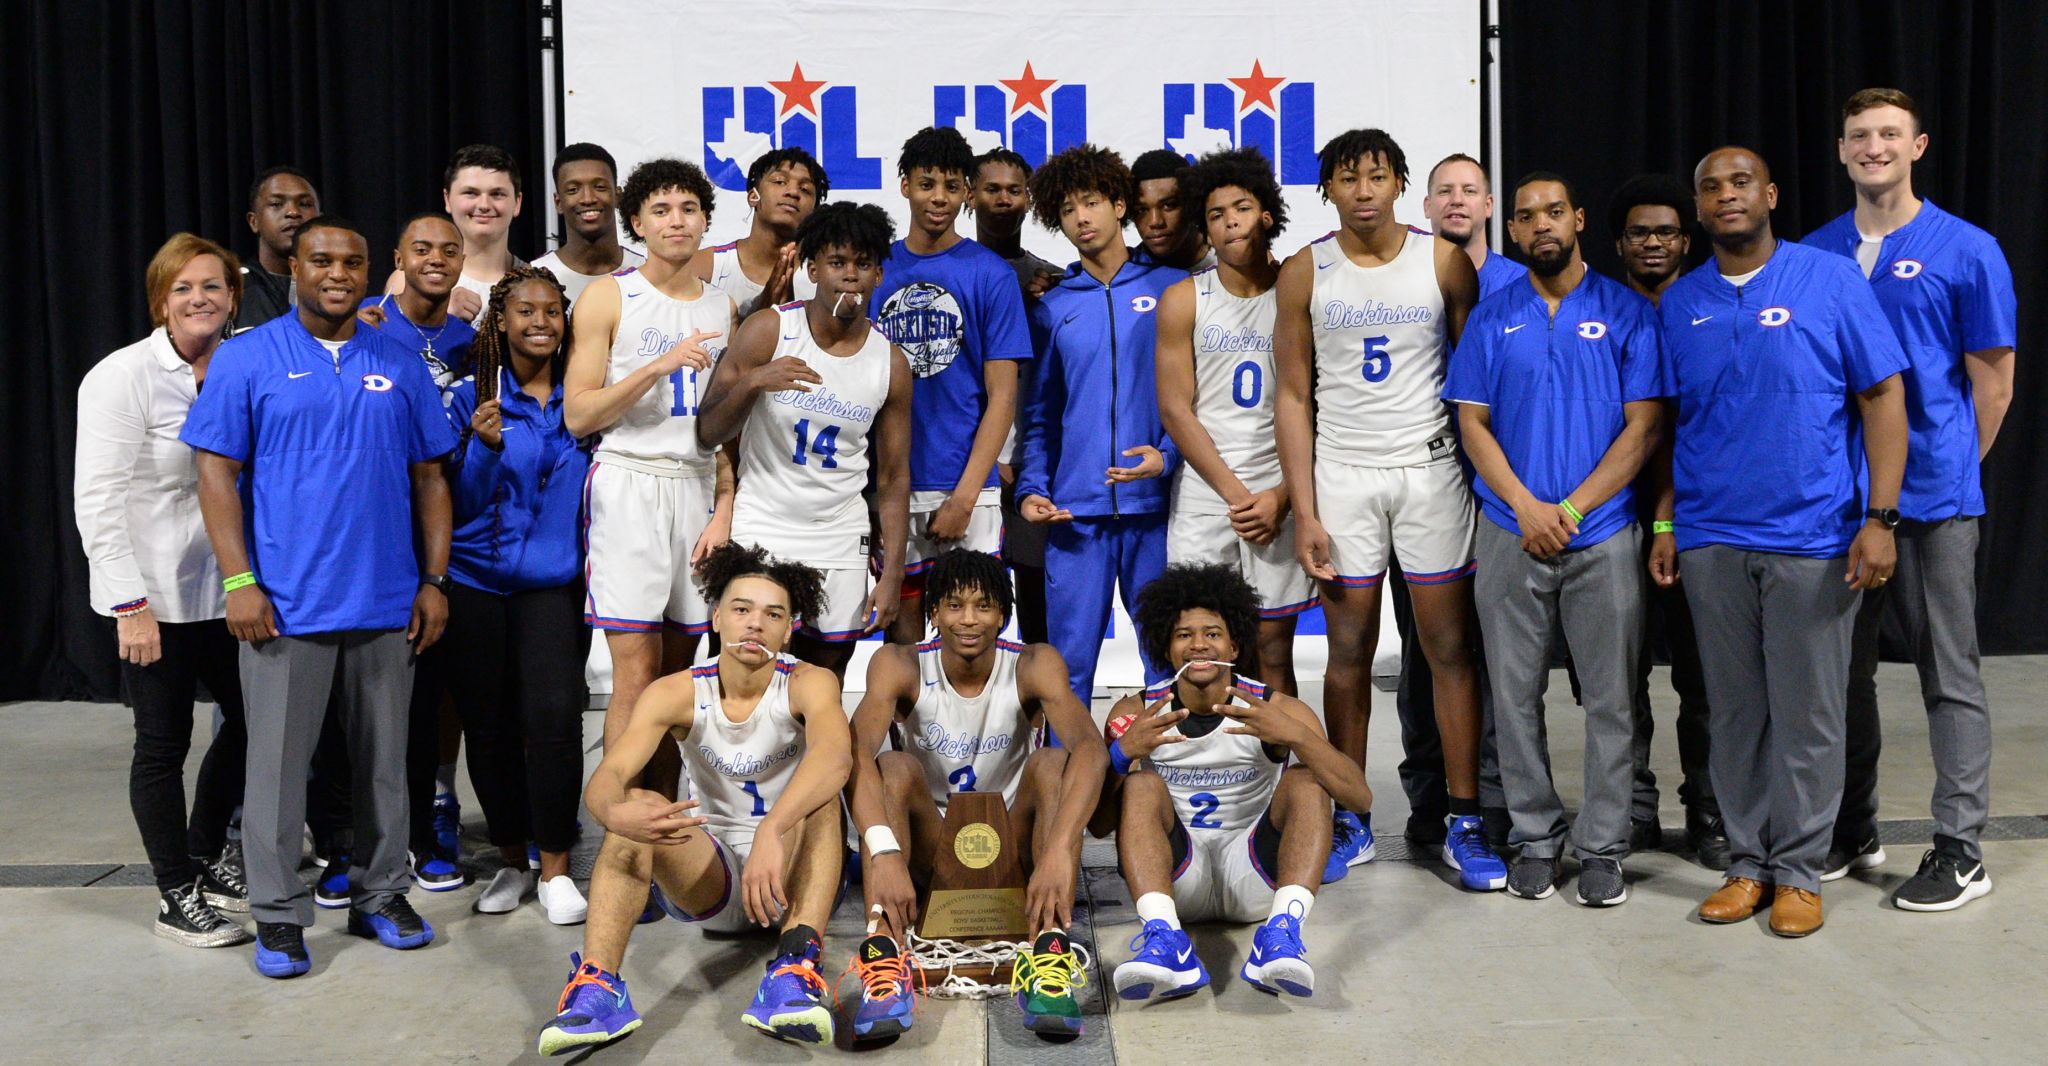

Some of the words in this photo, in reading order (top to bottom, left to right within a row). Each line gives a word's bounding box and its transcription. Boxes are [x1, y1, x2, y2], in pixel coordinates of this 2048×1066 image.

[702, 61, 882, 192] UIL
[1894, 260, 1922, 278] D
[1131, 296, 1157, 312] D
[1323, 300, 1431, 330] Dickinson
[1759, 307, 1790, 326] D
[881, 308, 958, 344] DICKINSON
[1201, 324, 1274, 353] Dickins
[1578, 321, 1606, 338] D
[1362, 334, 1392, 383] 5
[363, 374, 393, 391] D
[1232, 360, 1263, 409] 0
[773, 381, 872, 422] Dickinson
[792, 418, 841, 469] 14
[699, 743, 798, 777] Dickinson
[1153, 761, 1258, 789] Dickinson
[742, 781, 769, 816] 1
[1189, 792, 1223, 828] 2
